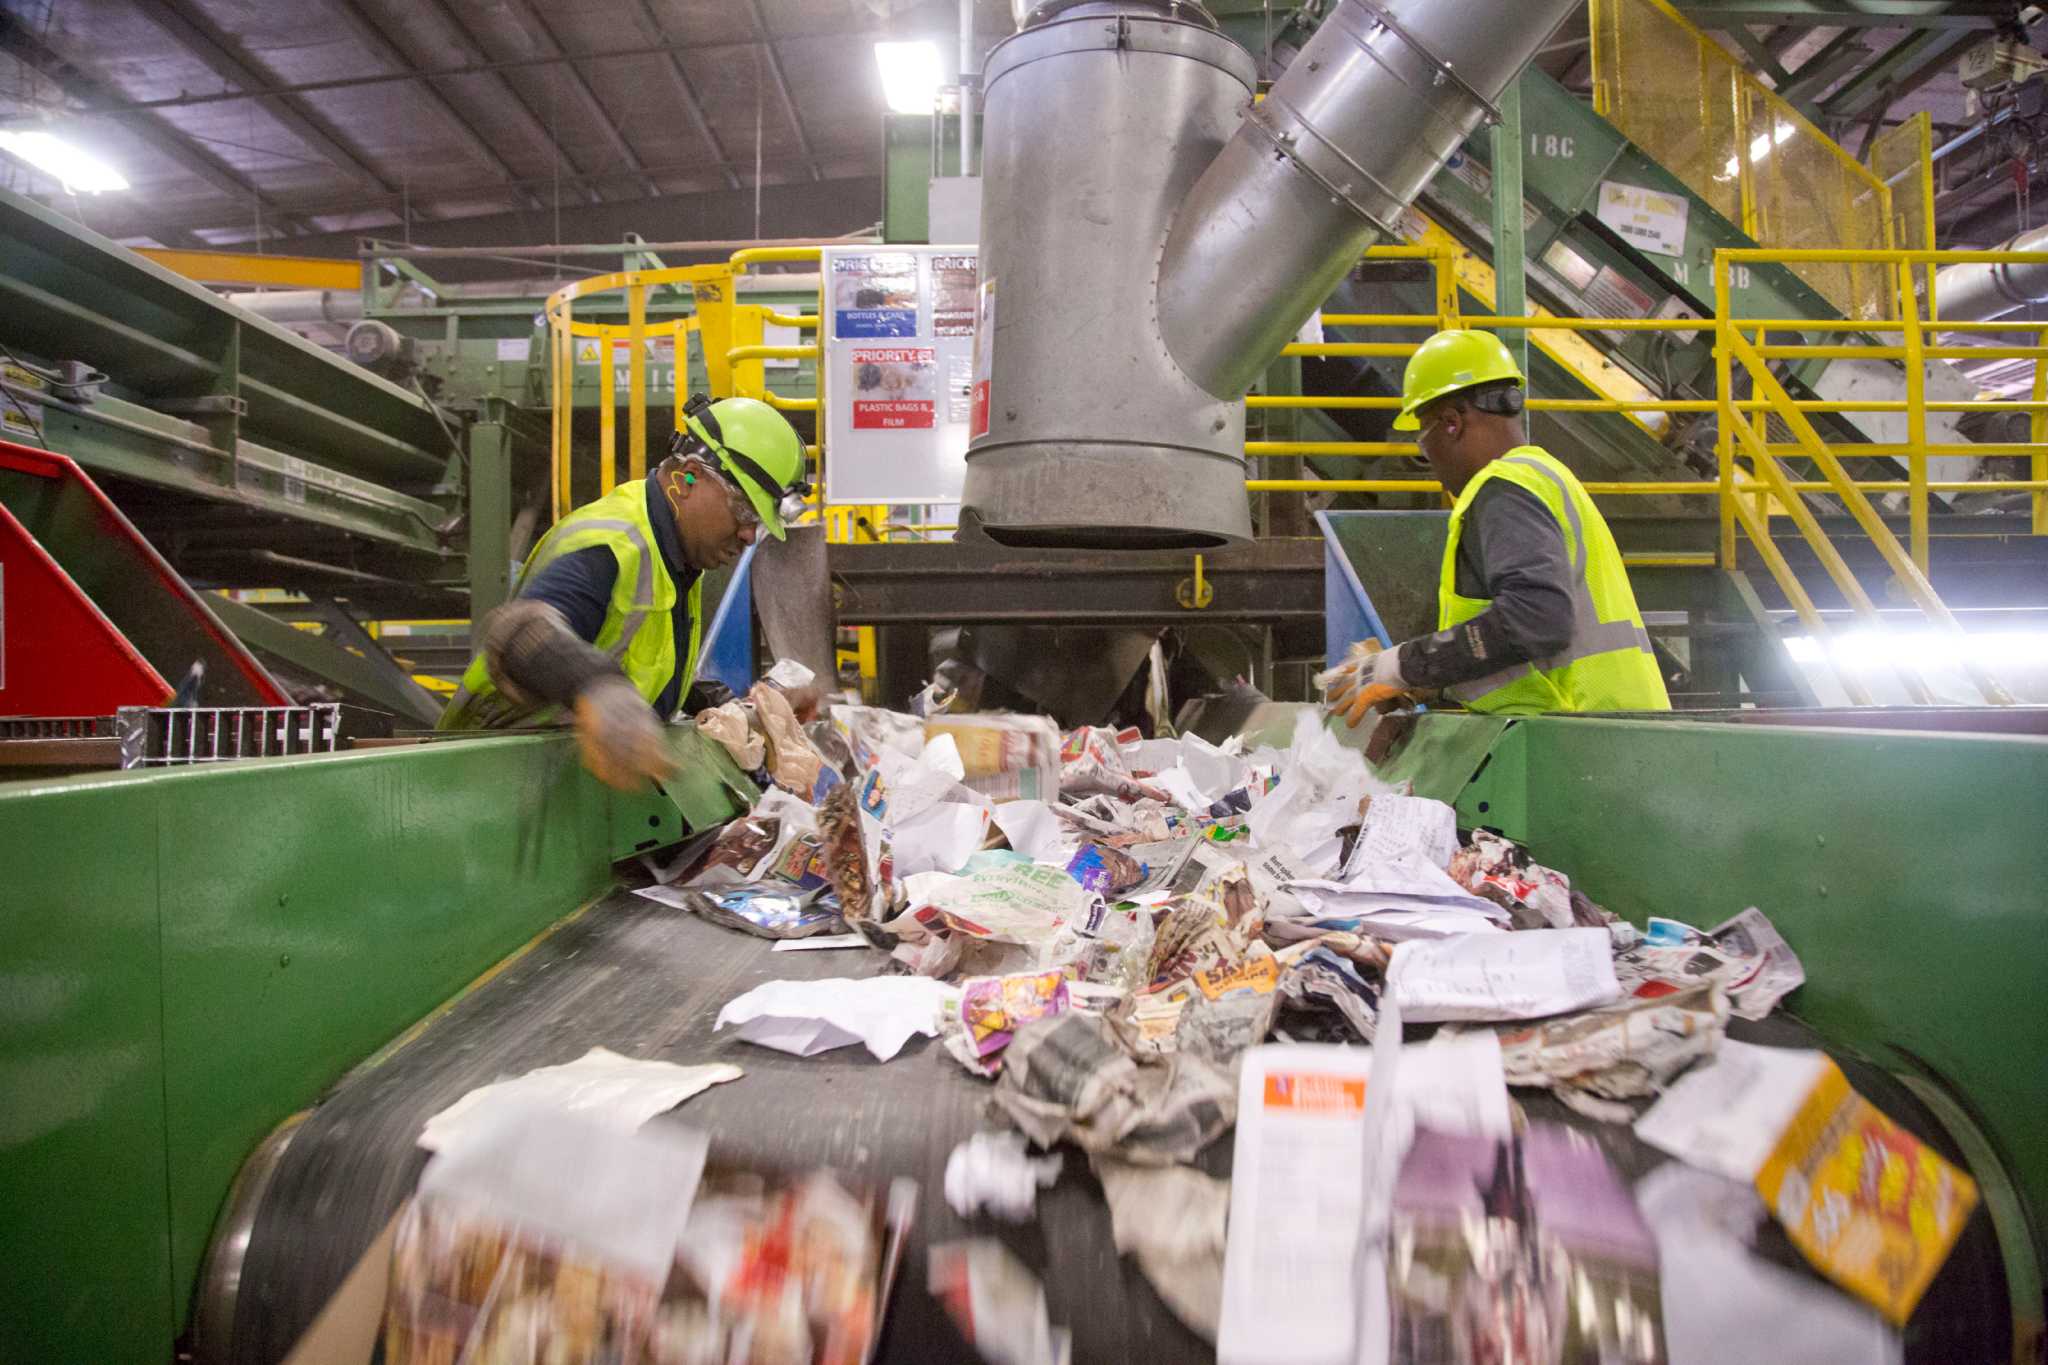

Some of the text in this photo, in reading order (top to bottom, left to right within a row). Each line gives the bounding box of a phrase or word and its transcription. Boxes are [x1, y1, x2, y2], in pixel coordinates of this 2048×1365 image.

[859, 403, 928, 412] PLASTIC BAGS &
[883, 417, 905, 426] FILM
